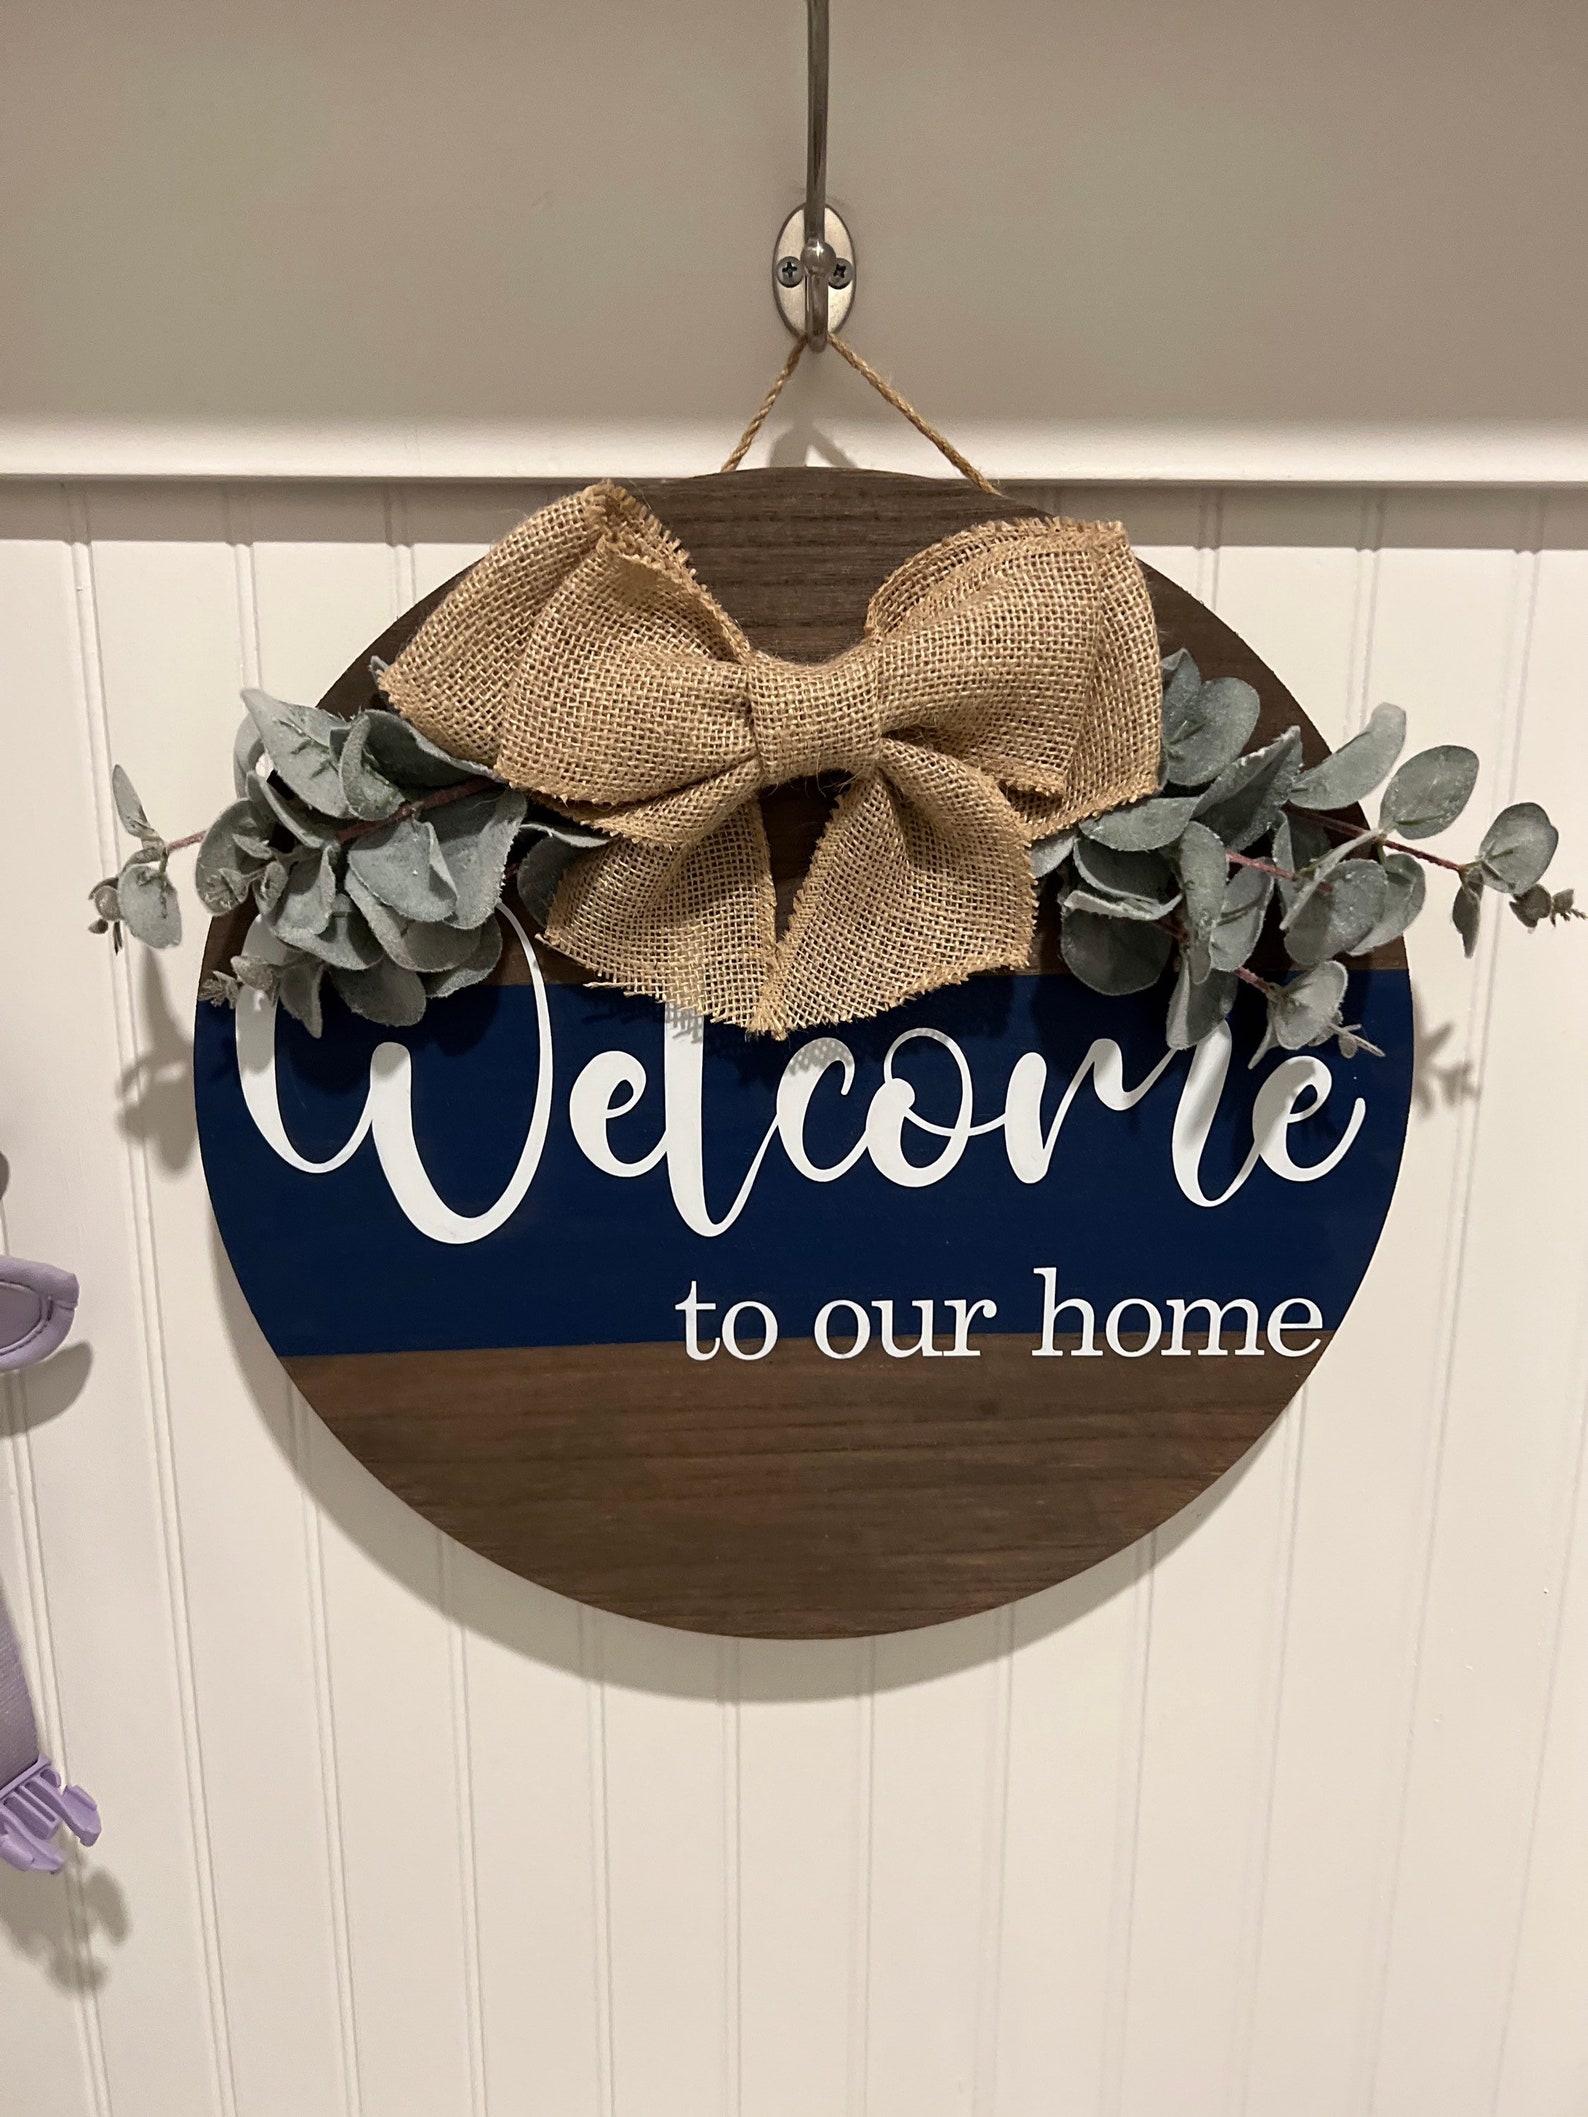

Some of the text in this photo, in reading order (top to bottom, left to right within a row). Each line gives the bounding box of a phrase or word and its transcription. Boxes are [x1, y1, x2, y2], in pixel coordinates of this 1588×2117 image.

[234, 900, 1367, 1245] Welcome
[674, 1267, 1324, 1361] to our home
